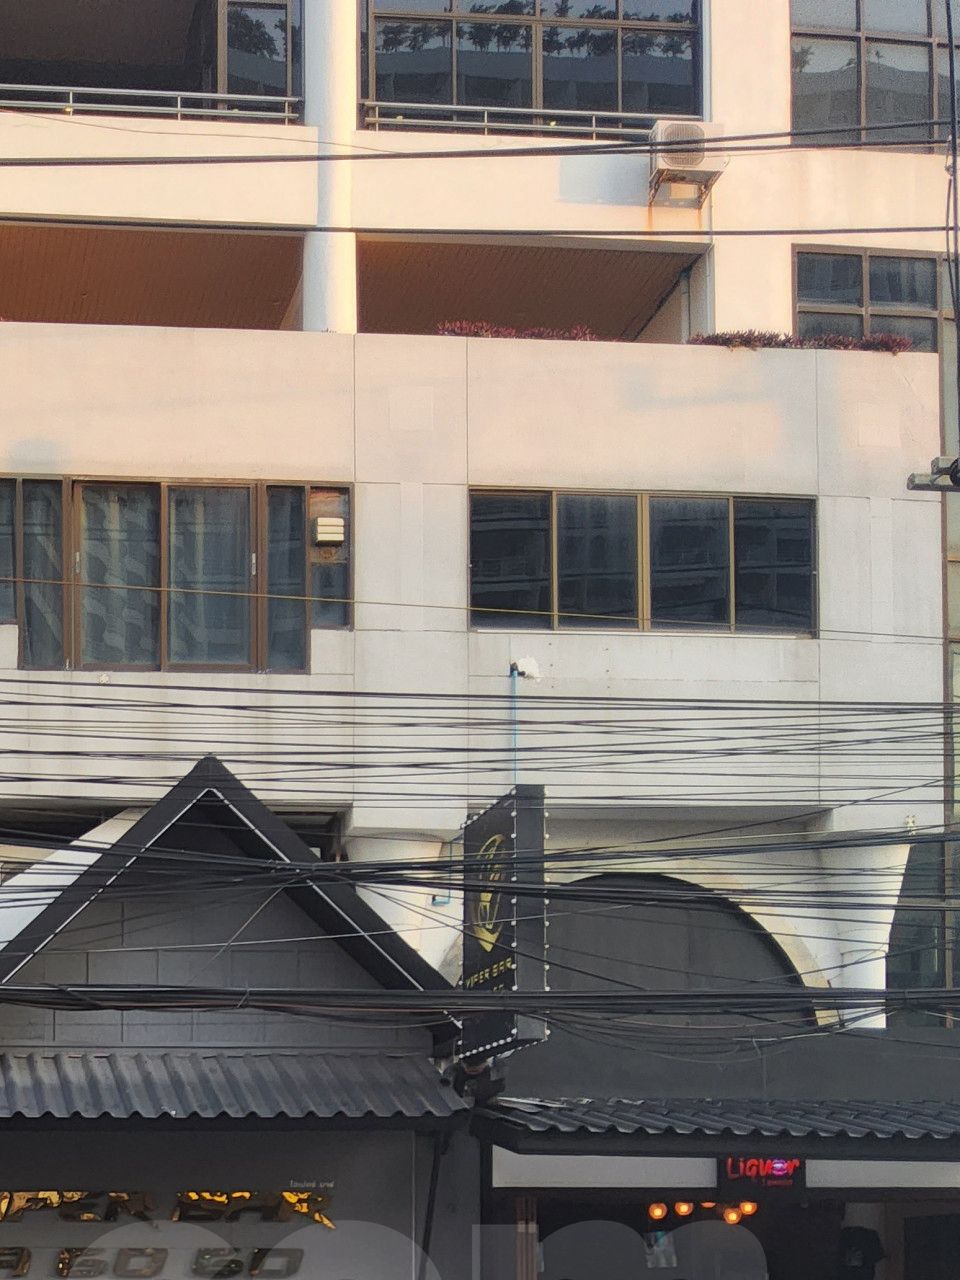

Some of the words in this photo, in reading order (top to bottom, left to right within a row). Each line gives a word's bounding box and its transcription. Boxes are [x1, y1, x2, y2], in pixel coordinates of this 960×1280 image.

[171, 1190, 337, 1230] BAR
[54, 1247, 169, 1279] GO
[190, 1247, 306, 1279] GO
